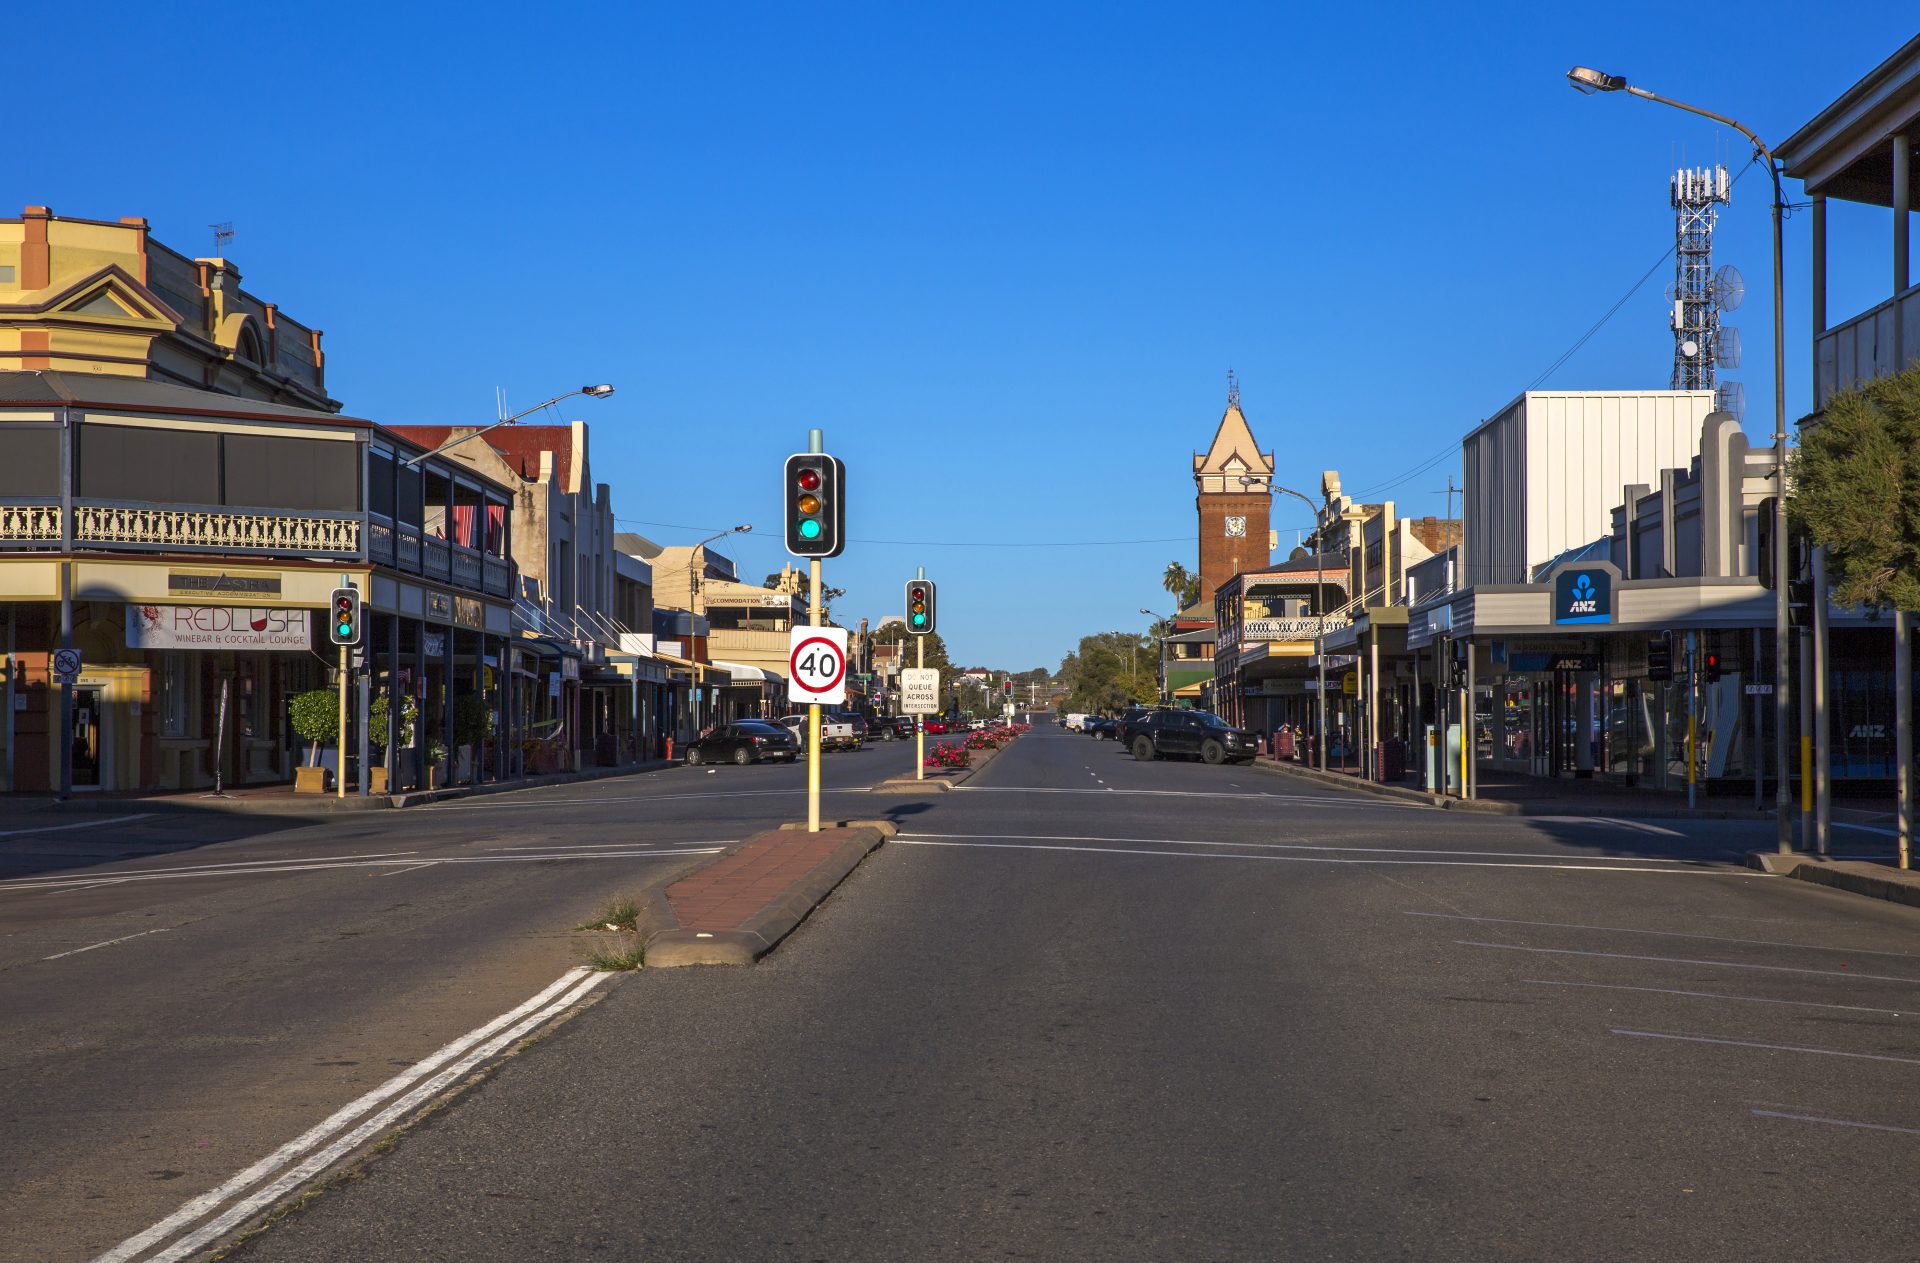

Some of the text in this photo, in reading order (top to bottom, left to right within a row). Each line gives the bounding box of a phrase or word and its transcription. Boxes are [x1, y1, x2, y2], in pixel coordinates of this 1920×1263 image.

[182, 577, 208, 588] THE
[1570, 601, 1596, 612] ANZ
[174, 607, 305, 632] REDLUSH
[175, 633, 305, 645] WINEBAR & COCKTAIL LOUNGE
[799, 653, 836, 678] 40
[1556, 660, 1582, 668] ANZ
[920, 674, 934, 682] NOT
[908, 683, 933, 691] QUEUE
[906, 693, 934, 701] ACROSS
[1849, 725, 1885, 737] ANZ
